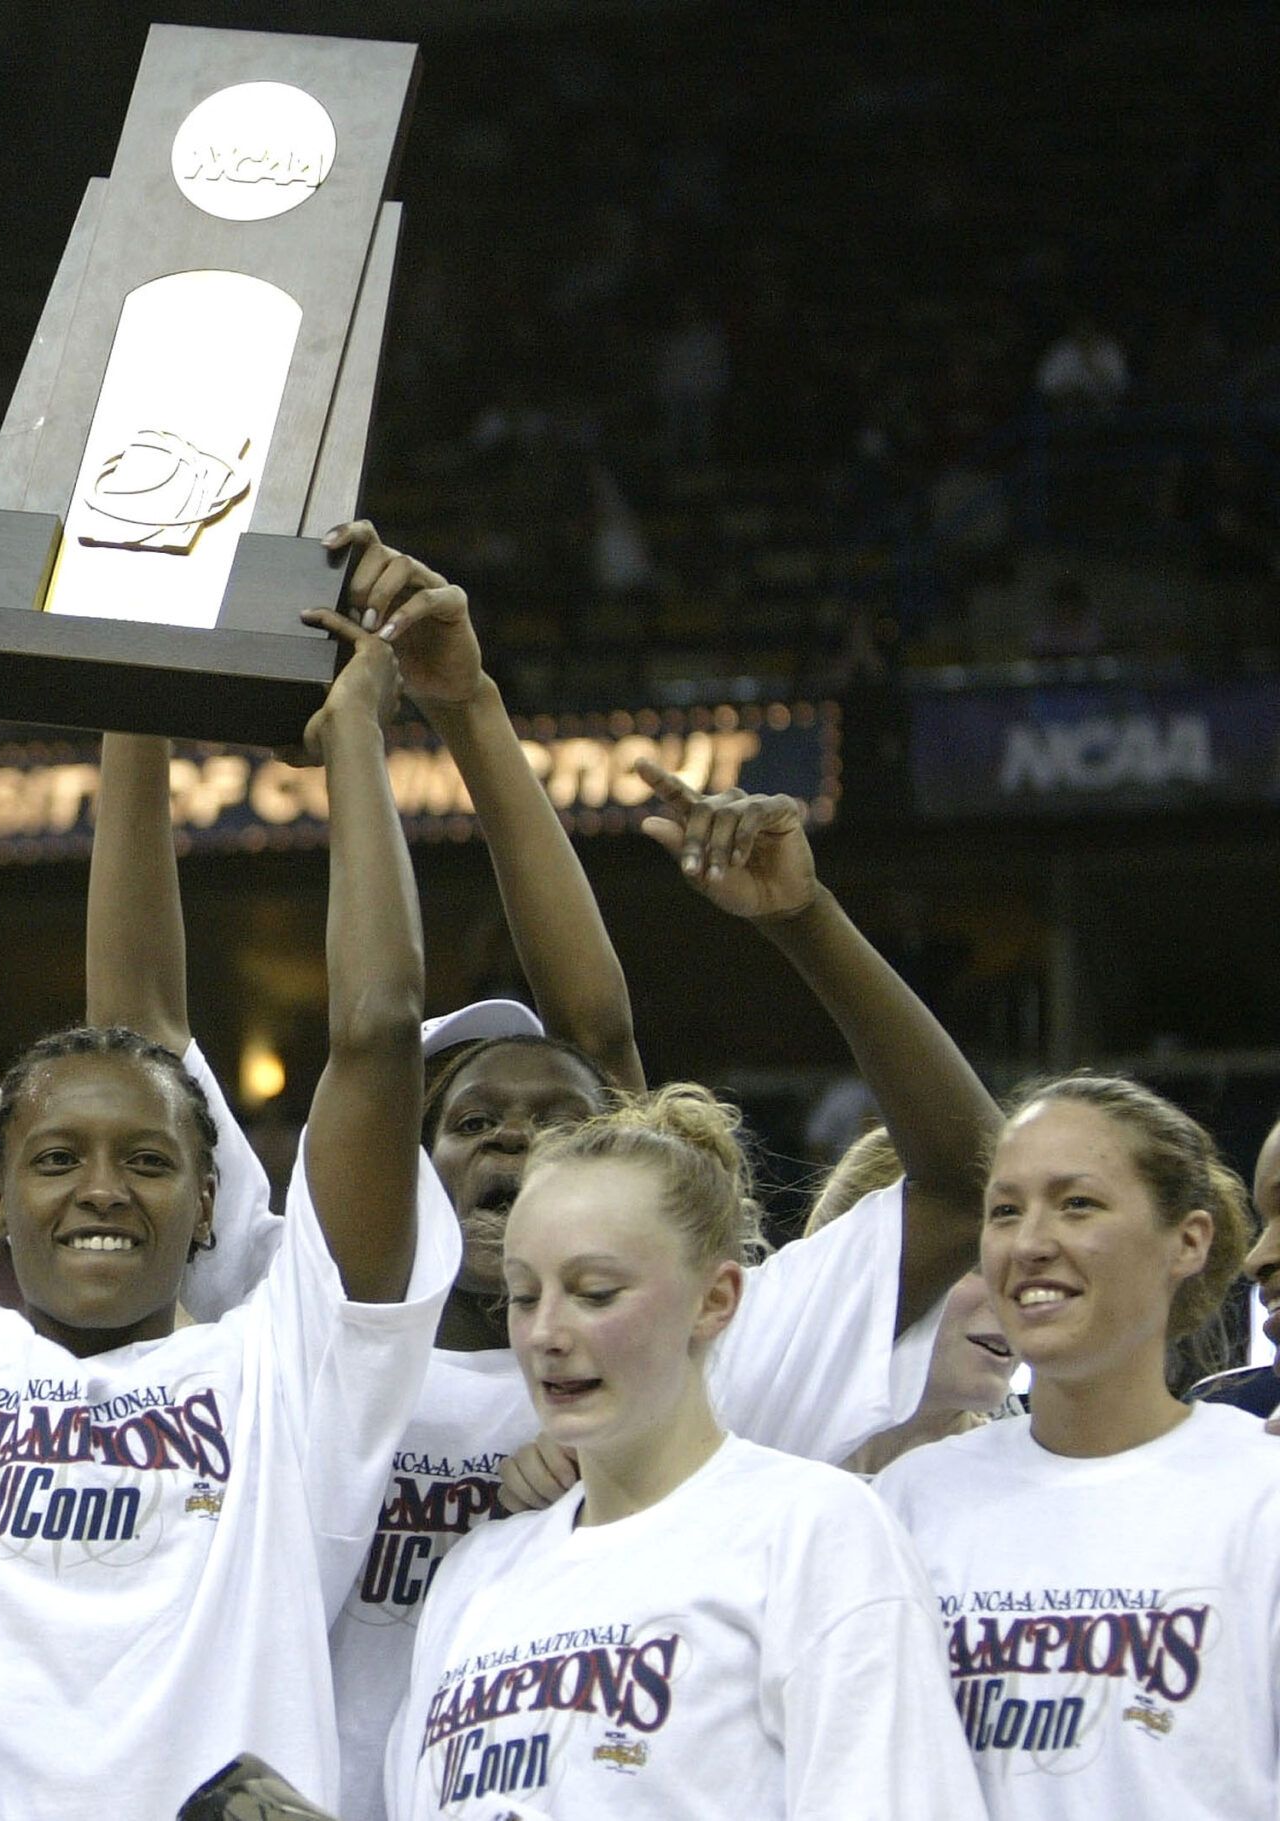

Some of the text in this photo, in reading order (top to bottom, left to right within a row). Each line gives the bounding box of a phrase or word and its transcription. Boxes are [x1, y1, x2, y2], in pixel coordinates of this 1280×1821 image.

[1001, 714, 1212, 790] NCAA
[23, 1378, 82, 1402] NCAA
[392, 1451, 457, 1478] NCAA
[970, 1589, 1035, 1612] NCAA
[1040, 1588, 1167, 1612] NATIONAL
[471, 1644, 519, 1674] NCAA
[524, 1623, 632, 1659] NATIONAL
[954, 1679, 1086, 1751] UConn
[438, 1727, 550, 1811] UConn
